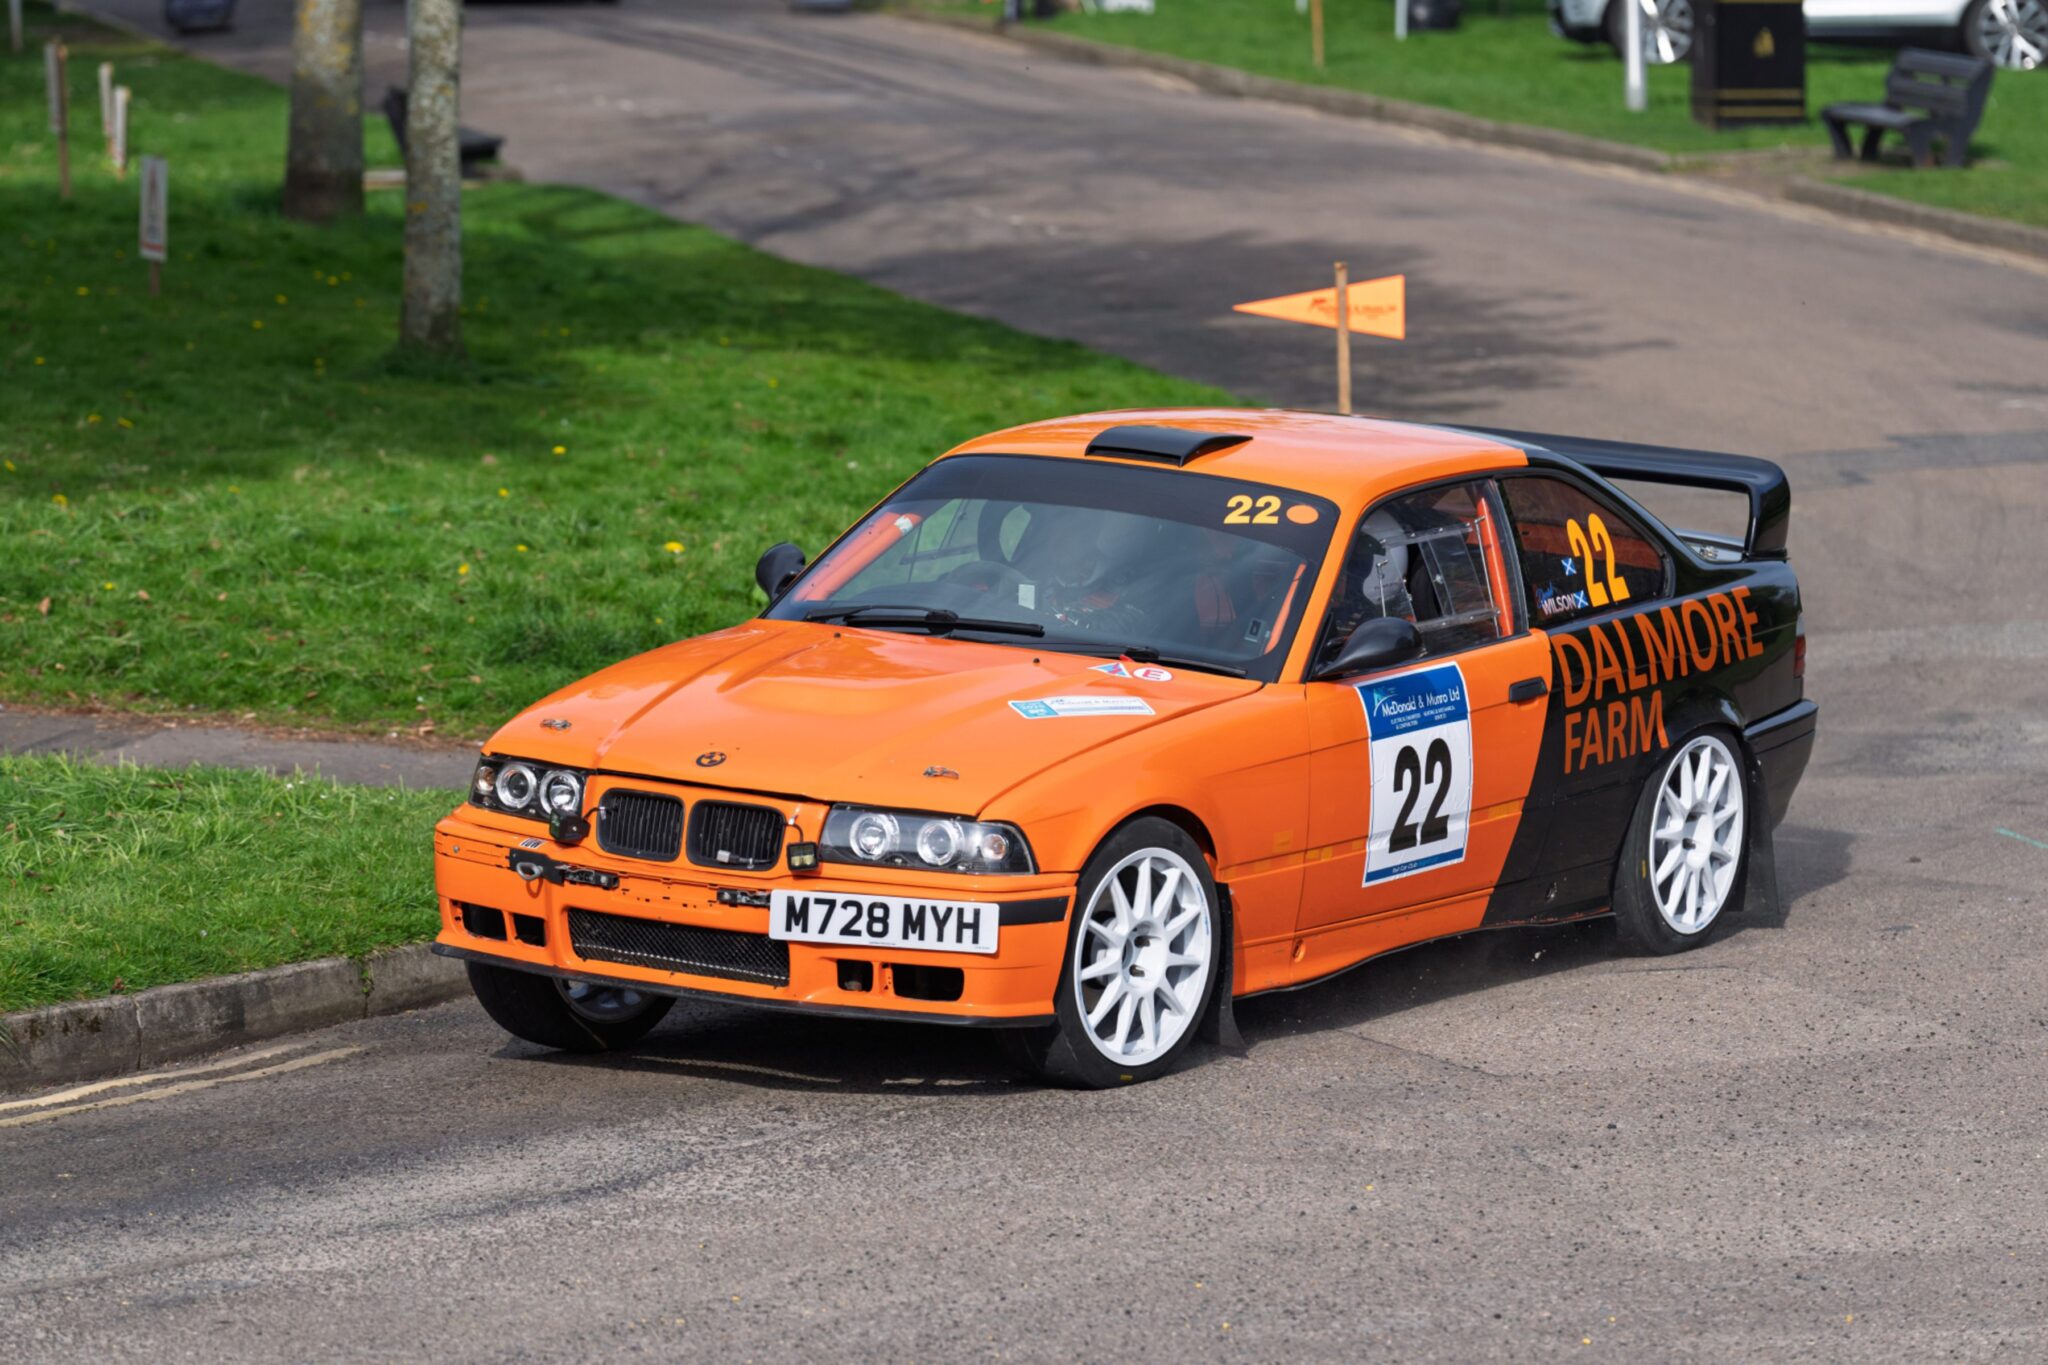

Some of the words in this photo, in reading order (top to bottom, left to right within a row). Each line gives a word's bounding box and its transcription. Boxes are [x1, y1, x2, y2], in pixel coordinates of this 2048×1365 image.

[1223, 494, 1282, 524] 22
[1565, 512, 1631, 608] 22
[1541, 592, 1577, 616] WILSON
[1550, 585, 1764, 708] DALMORE
[1381, 695, 1417, 718] McDonald
[1417, 694, 1425, 709] &
[1425, 691, 1449, 707] Munro
[1448, 685, 1461, 702] Ltd
[1564, 689, 1670, 775] FARM
[1388, 737, 1453, 854] 22
[784, 895, 891, 939] M728
[901, 903, 981, 945] MYH
